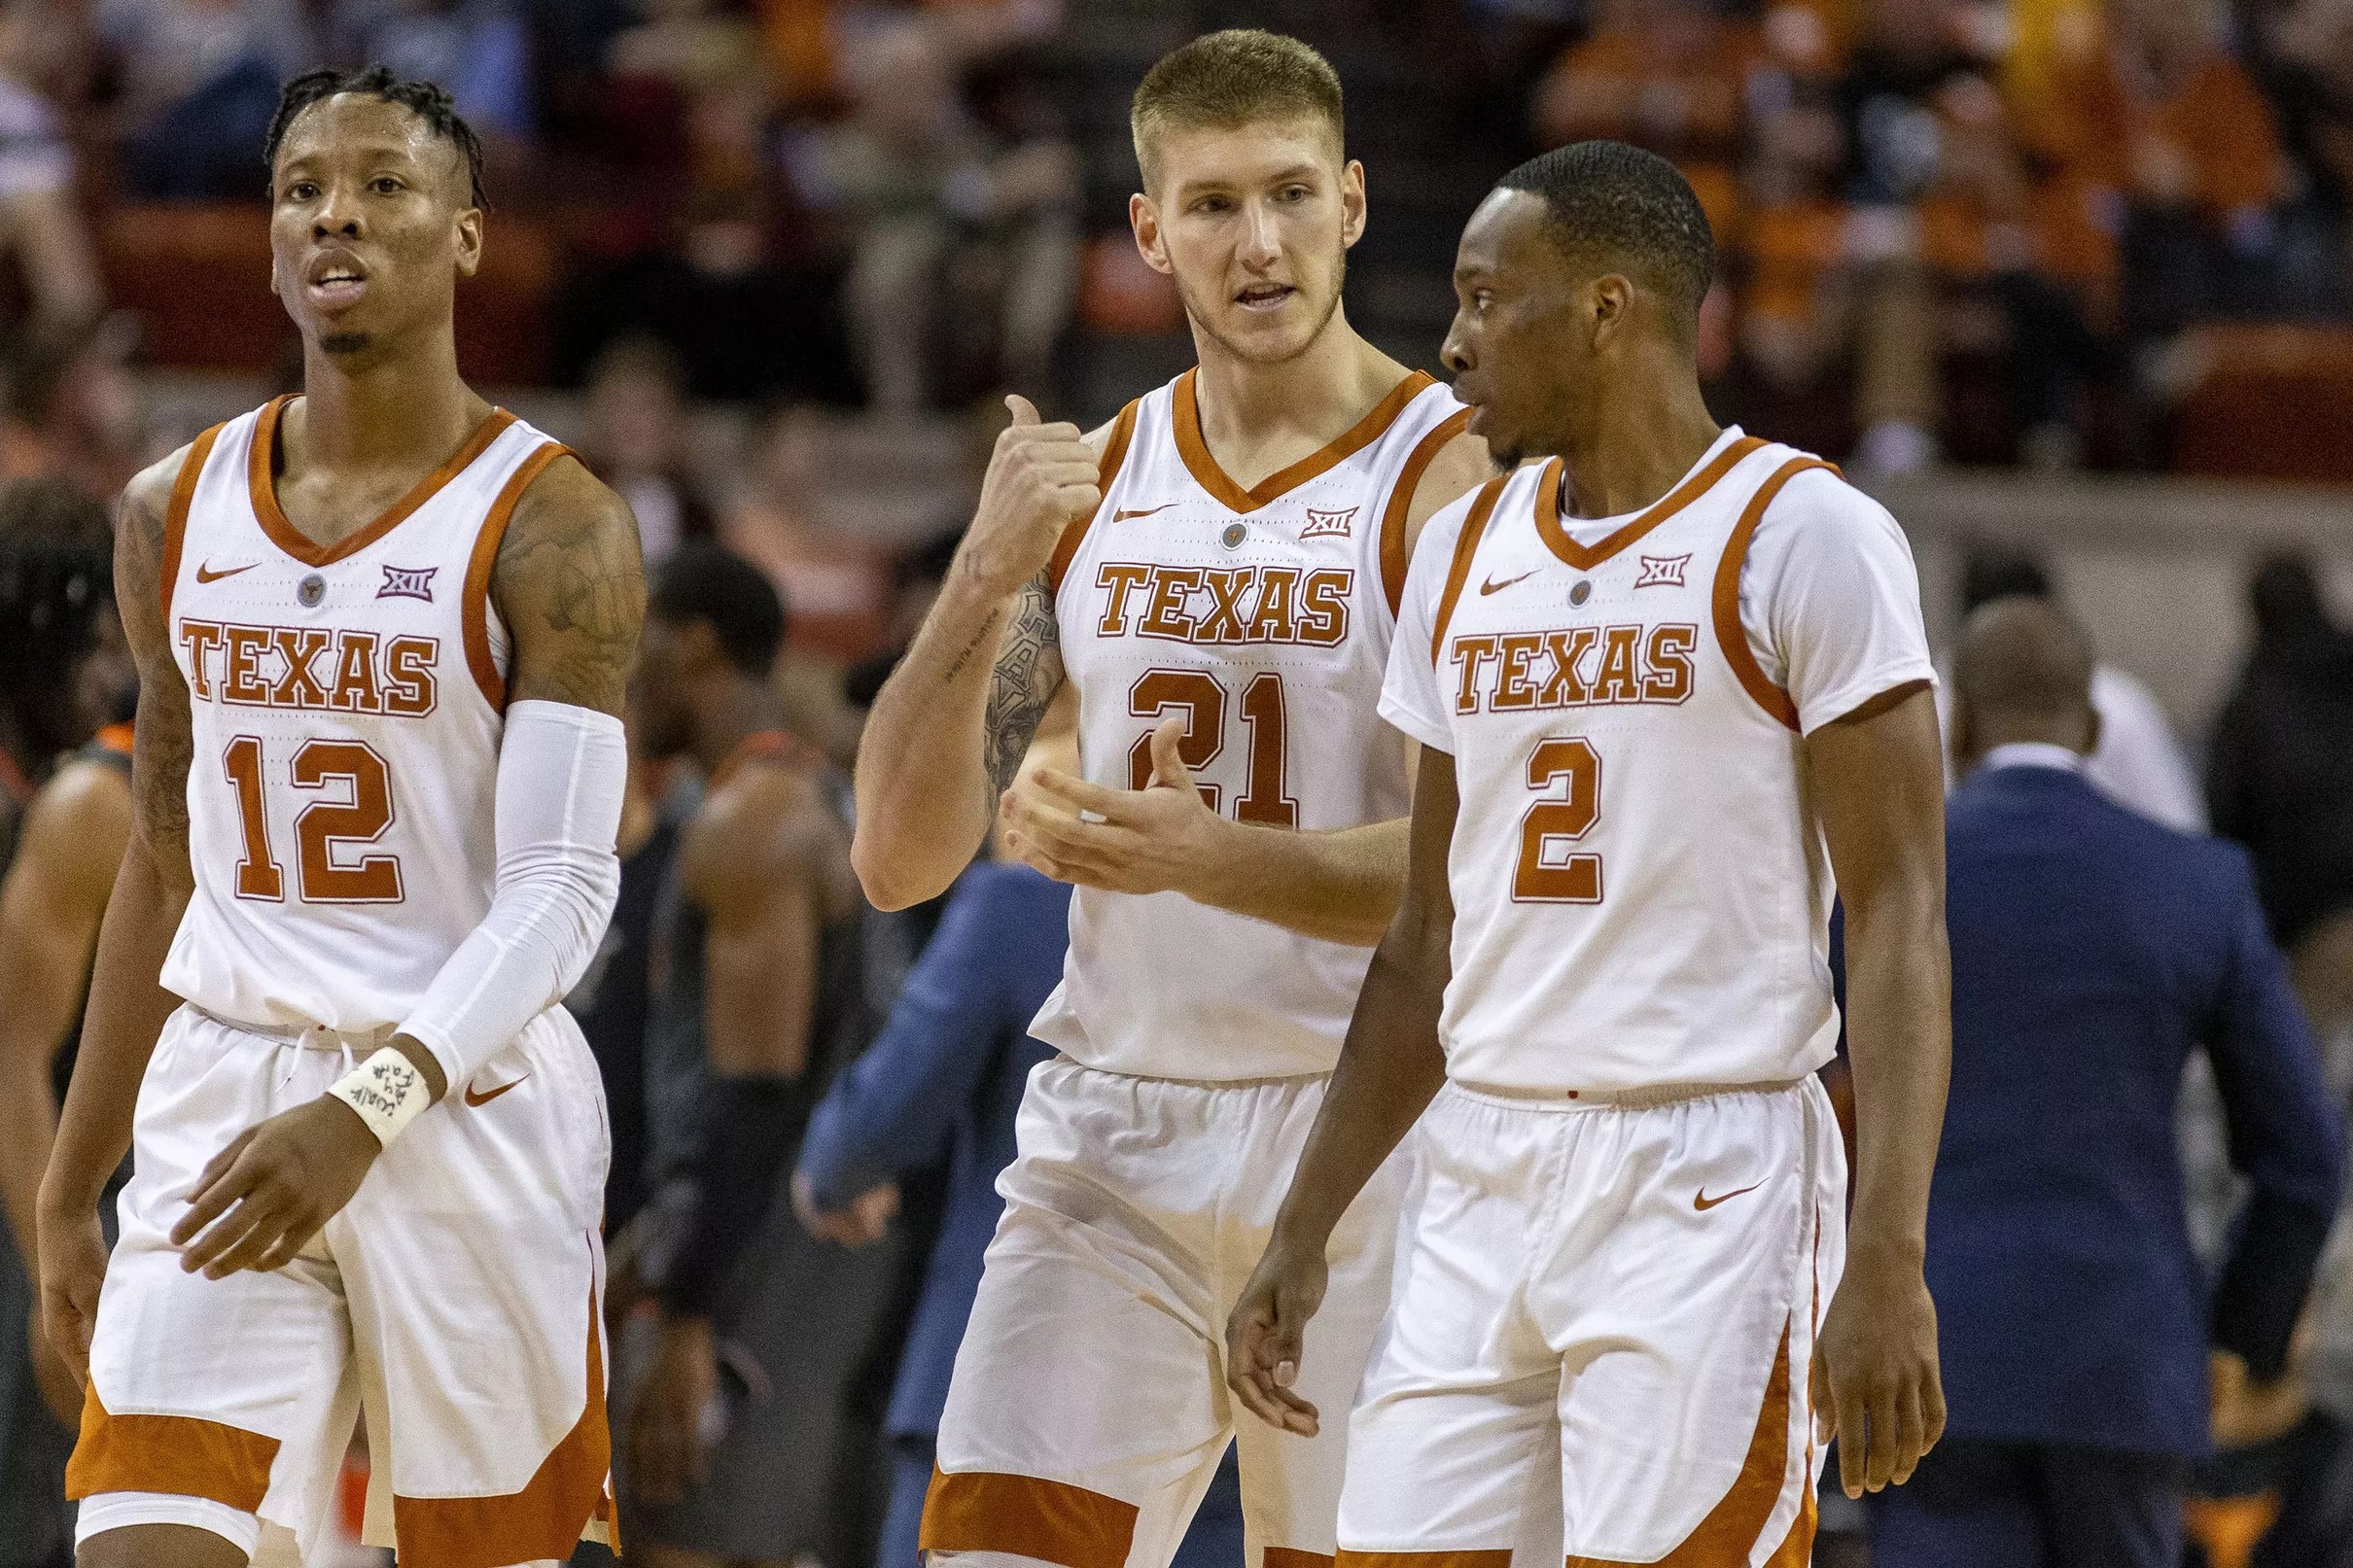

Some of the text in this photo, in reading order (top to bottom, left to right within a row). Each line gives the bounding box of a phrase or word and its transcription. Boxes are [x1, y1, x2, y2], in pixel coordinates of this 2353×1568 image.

[1301, 506, 1354, 538] XII
[377, 565, 436, 601] XII
[1095, 562, 1354, 648] TEXAS
[1636, 555, 1689, 587] XII
[179, 617, 439, 718] TEXAS
[1451, 623, 1699, 715] TEXAS
[1128, 668, 1300, 831] 21
[222, 734, 405, 904] 12
[1511, 736, 1604, 904] 2
